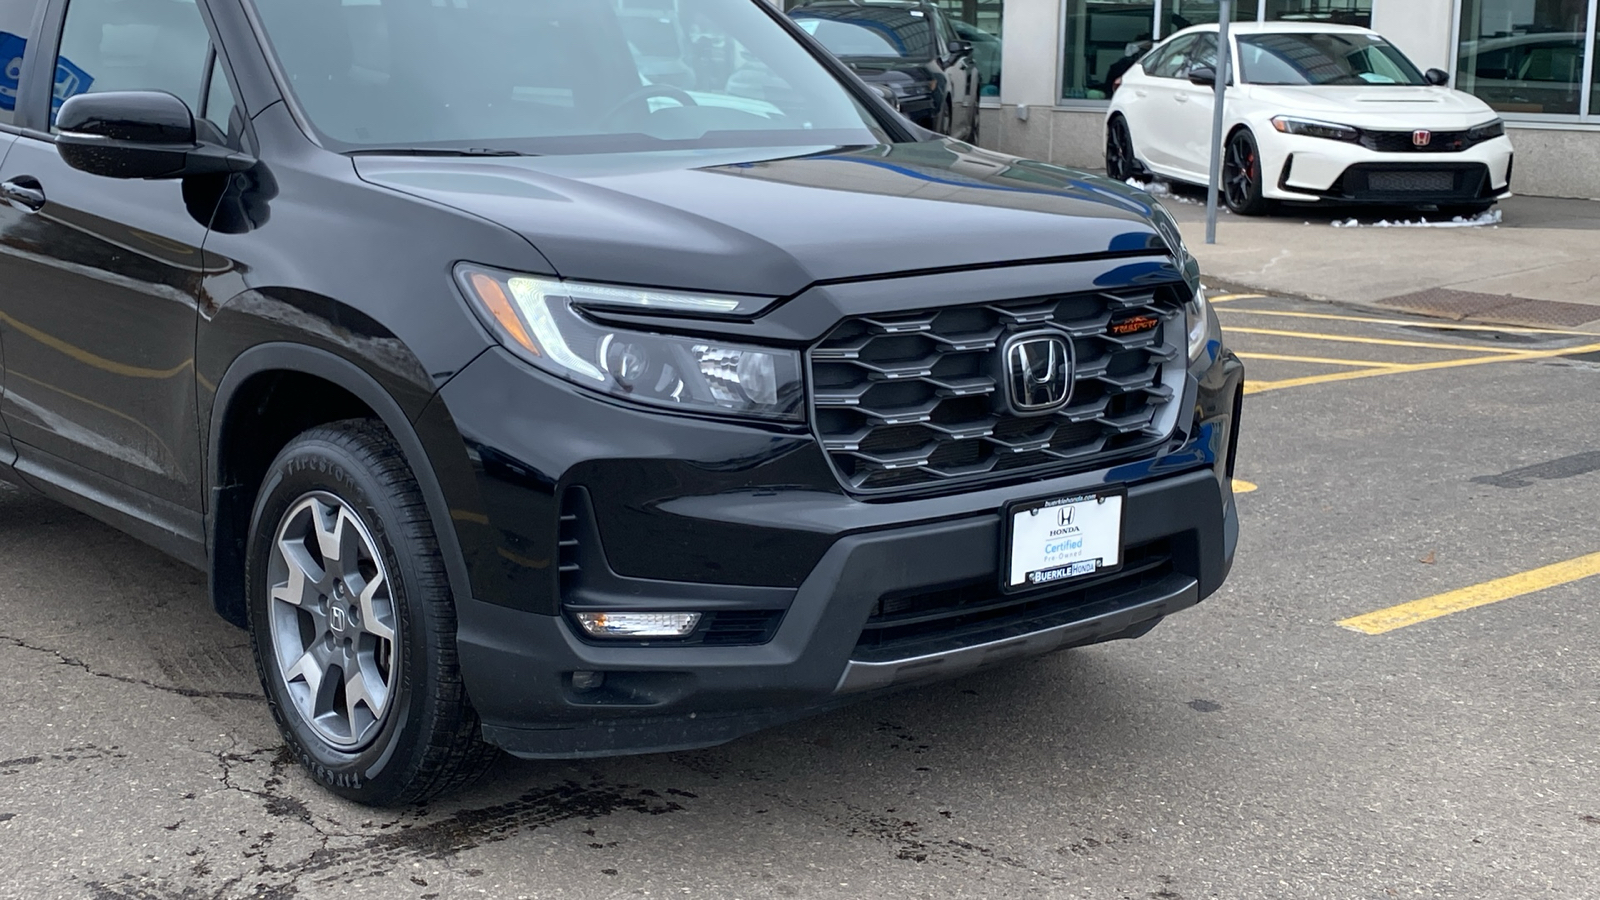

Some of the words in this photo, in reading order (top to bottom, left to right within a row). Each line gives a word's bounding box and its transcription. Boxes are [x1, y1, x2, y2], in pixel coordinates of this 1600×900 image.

[1049, 526, 1080, 536] HONDA
[1045, 538, 1083, 554] Certified
[1043, 550, 1083, 562] Pre-Owned
[1034, 566, 1072, 582] BUERKLE
[1072, 562, 1094, 574] HONDA
